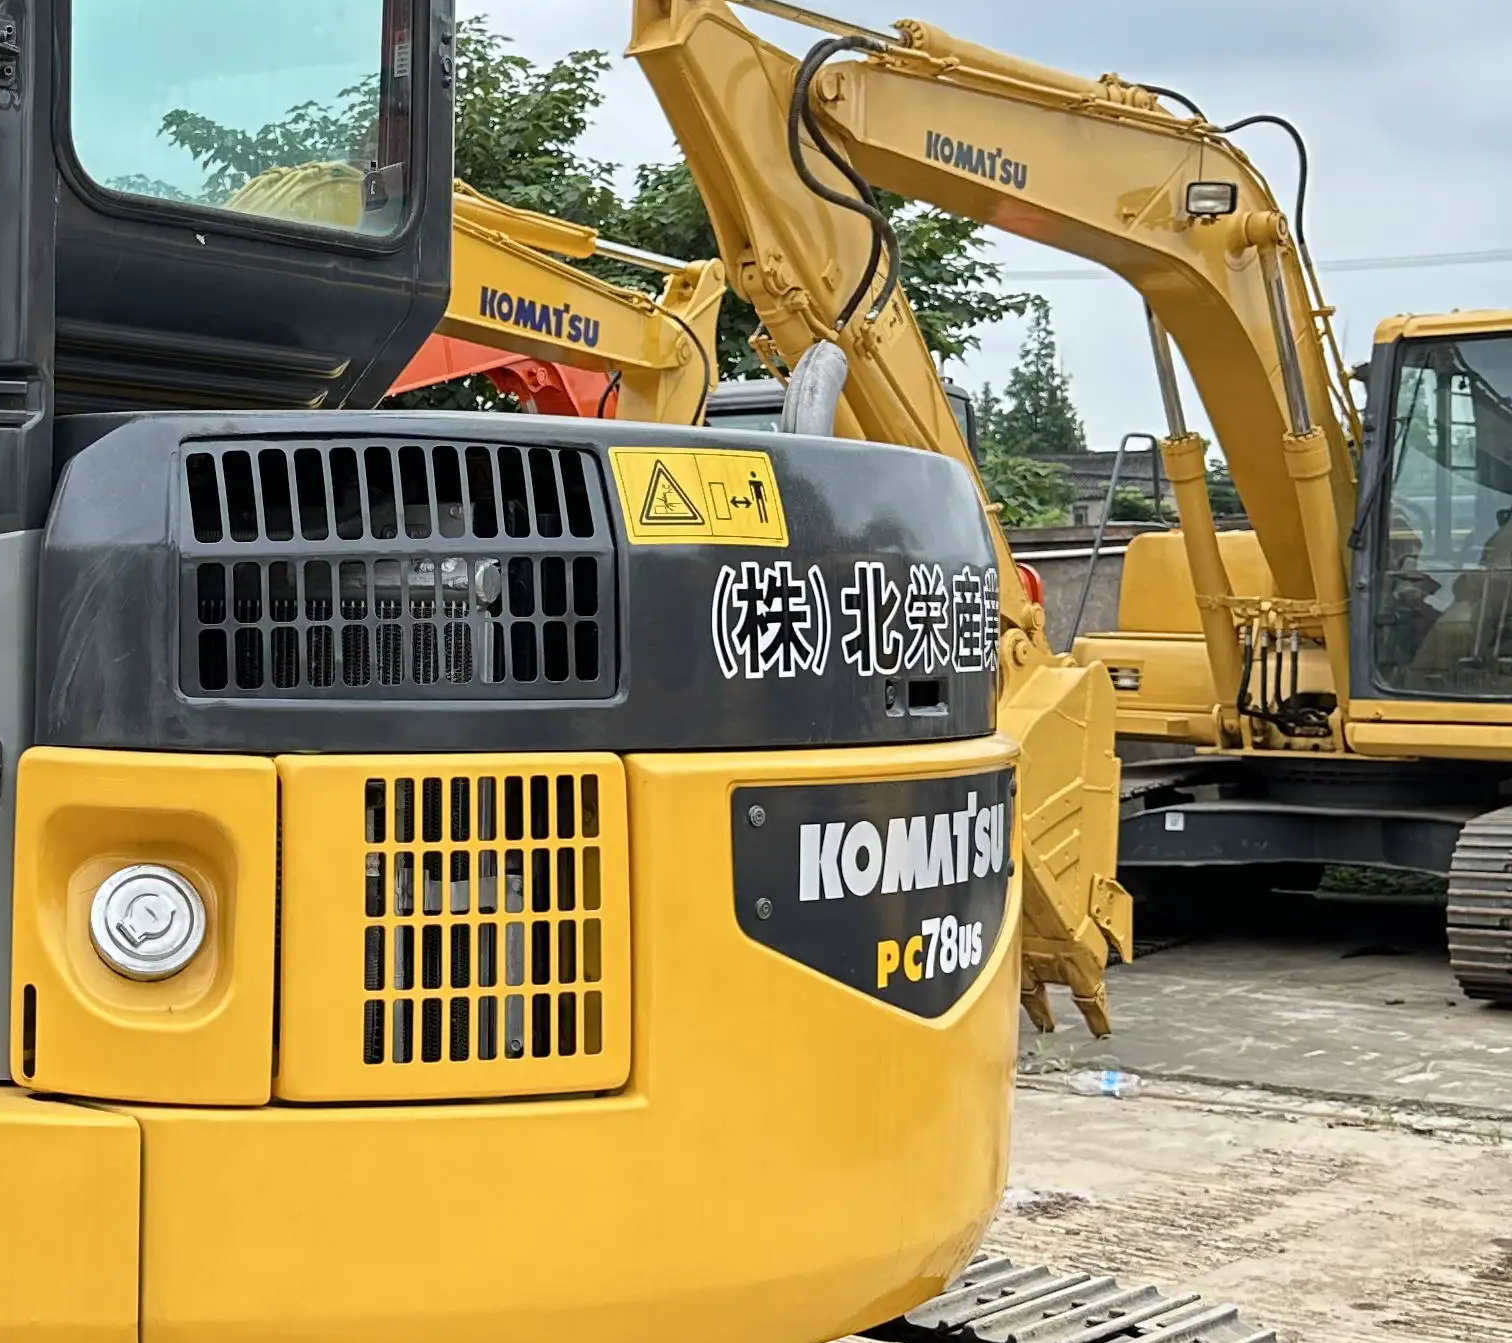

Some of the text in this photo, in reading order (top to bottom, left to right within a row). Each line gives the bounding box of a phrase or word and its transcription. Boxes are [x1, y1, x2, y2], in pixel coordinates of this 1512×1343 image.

[926, 130, 1027, 189] KOMATSU
[479, 286, 599, 347] KOMATSU
[799, 791, 1005, 901] KOMATSU
